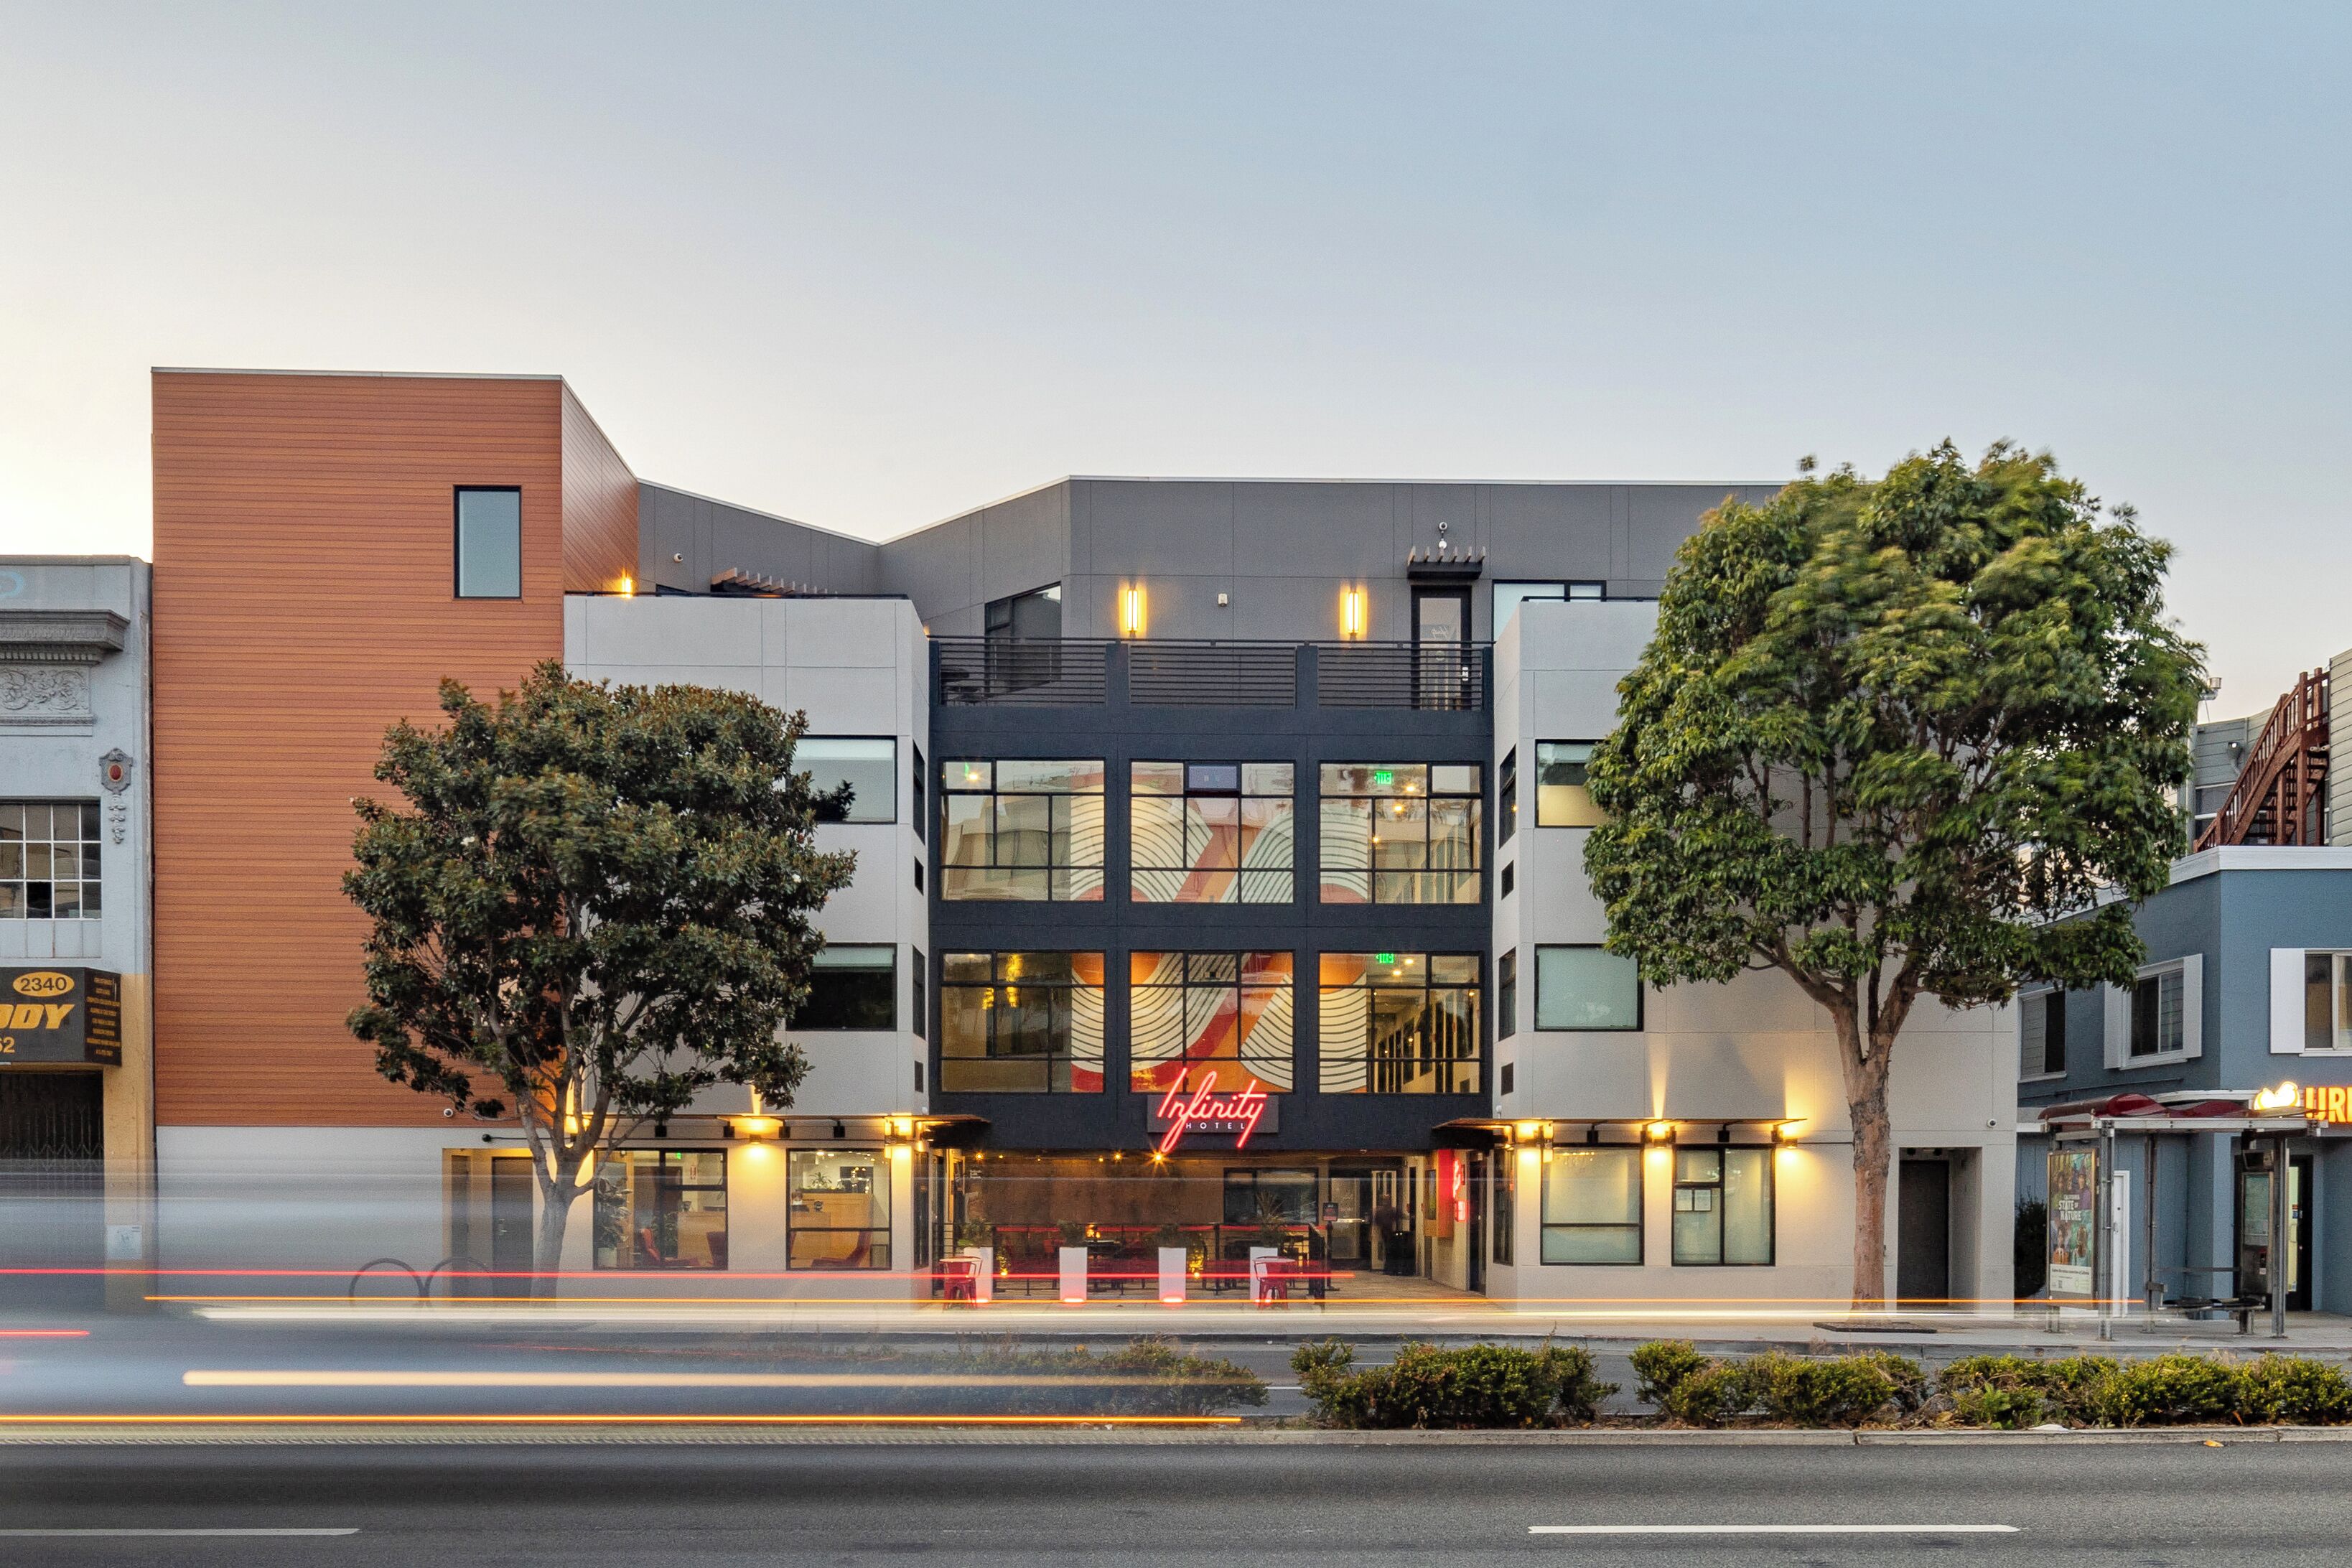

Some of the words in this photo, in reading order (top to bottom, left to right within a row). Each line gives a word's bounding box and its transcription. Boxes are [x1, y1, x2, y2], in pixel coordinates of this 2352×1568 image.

[20, 977, 67, 991] 2340
[0, 1037, 15, 1053] 2
[1157, 1068, 1267, 1152] Infinity
[2305, 1087, 2352, 1123] UR
[2058, 1200, 2074, 1210] STATE
[2060, 1210, 2081, 1222] NATURE
